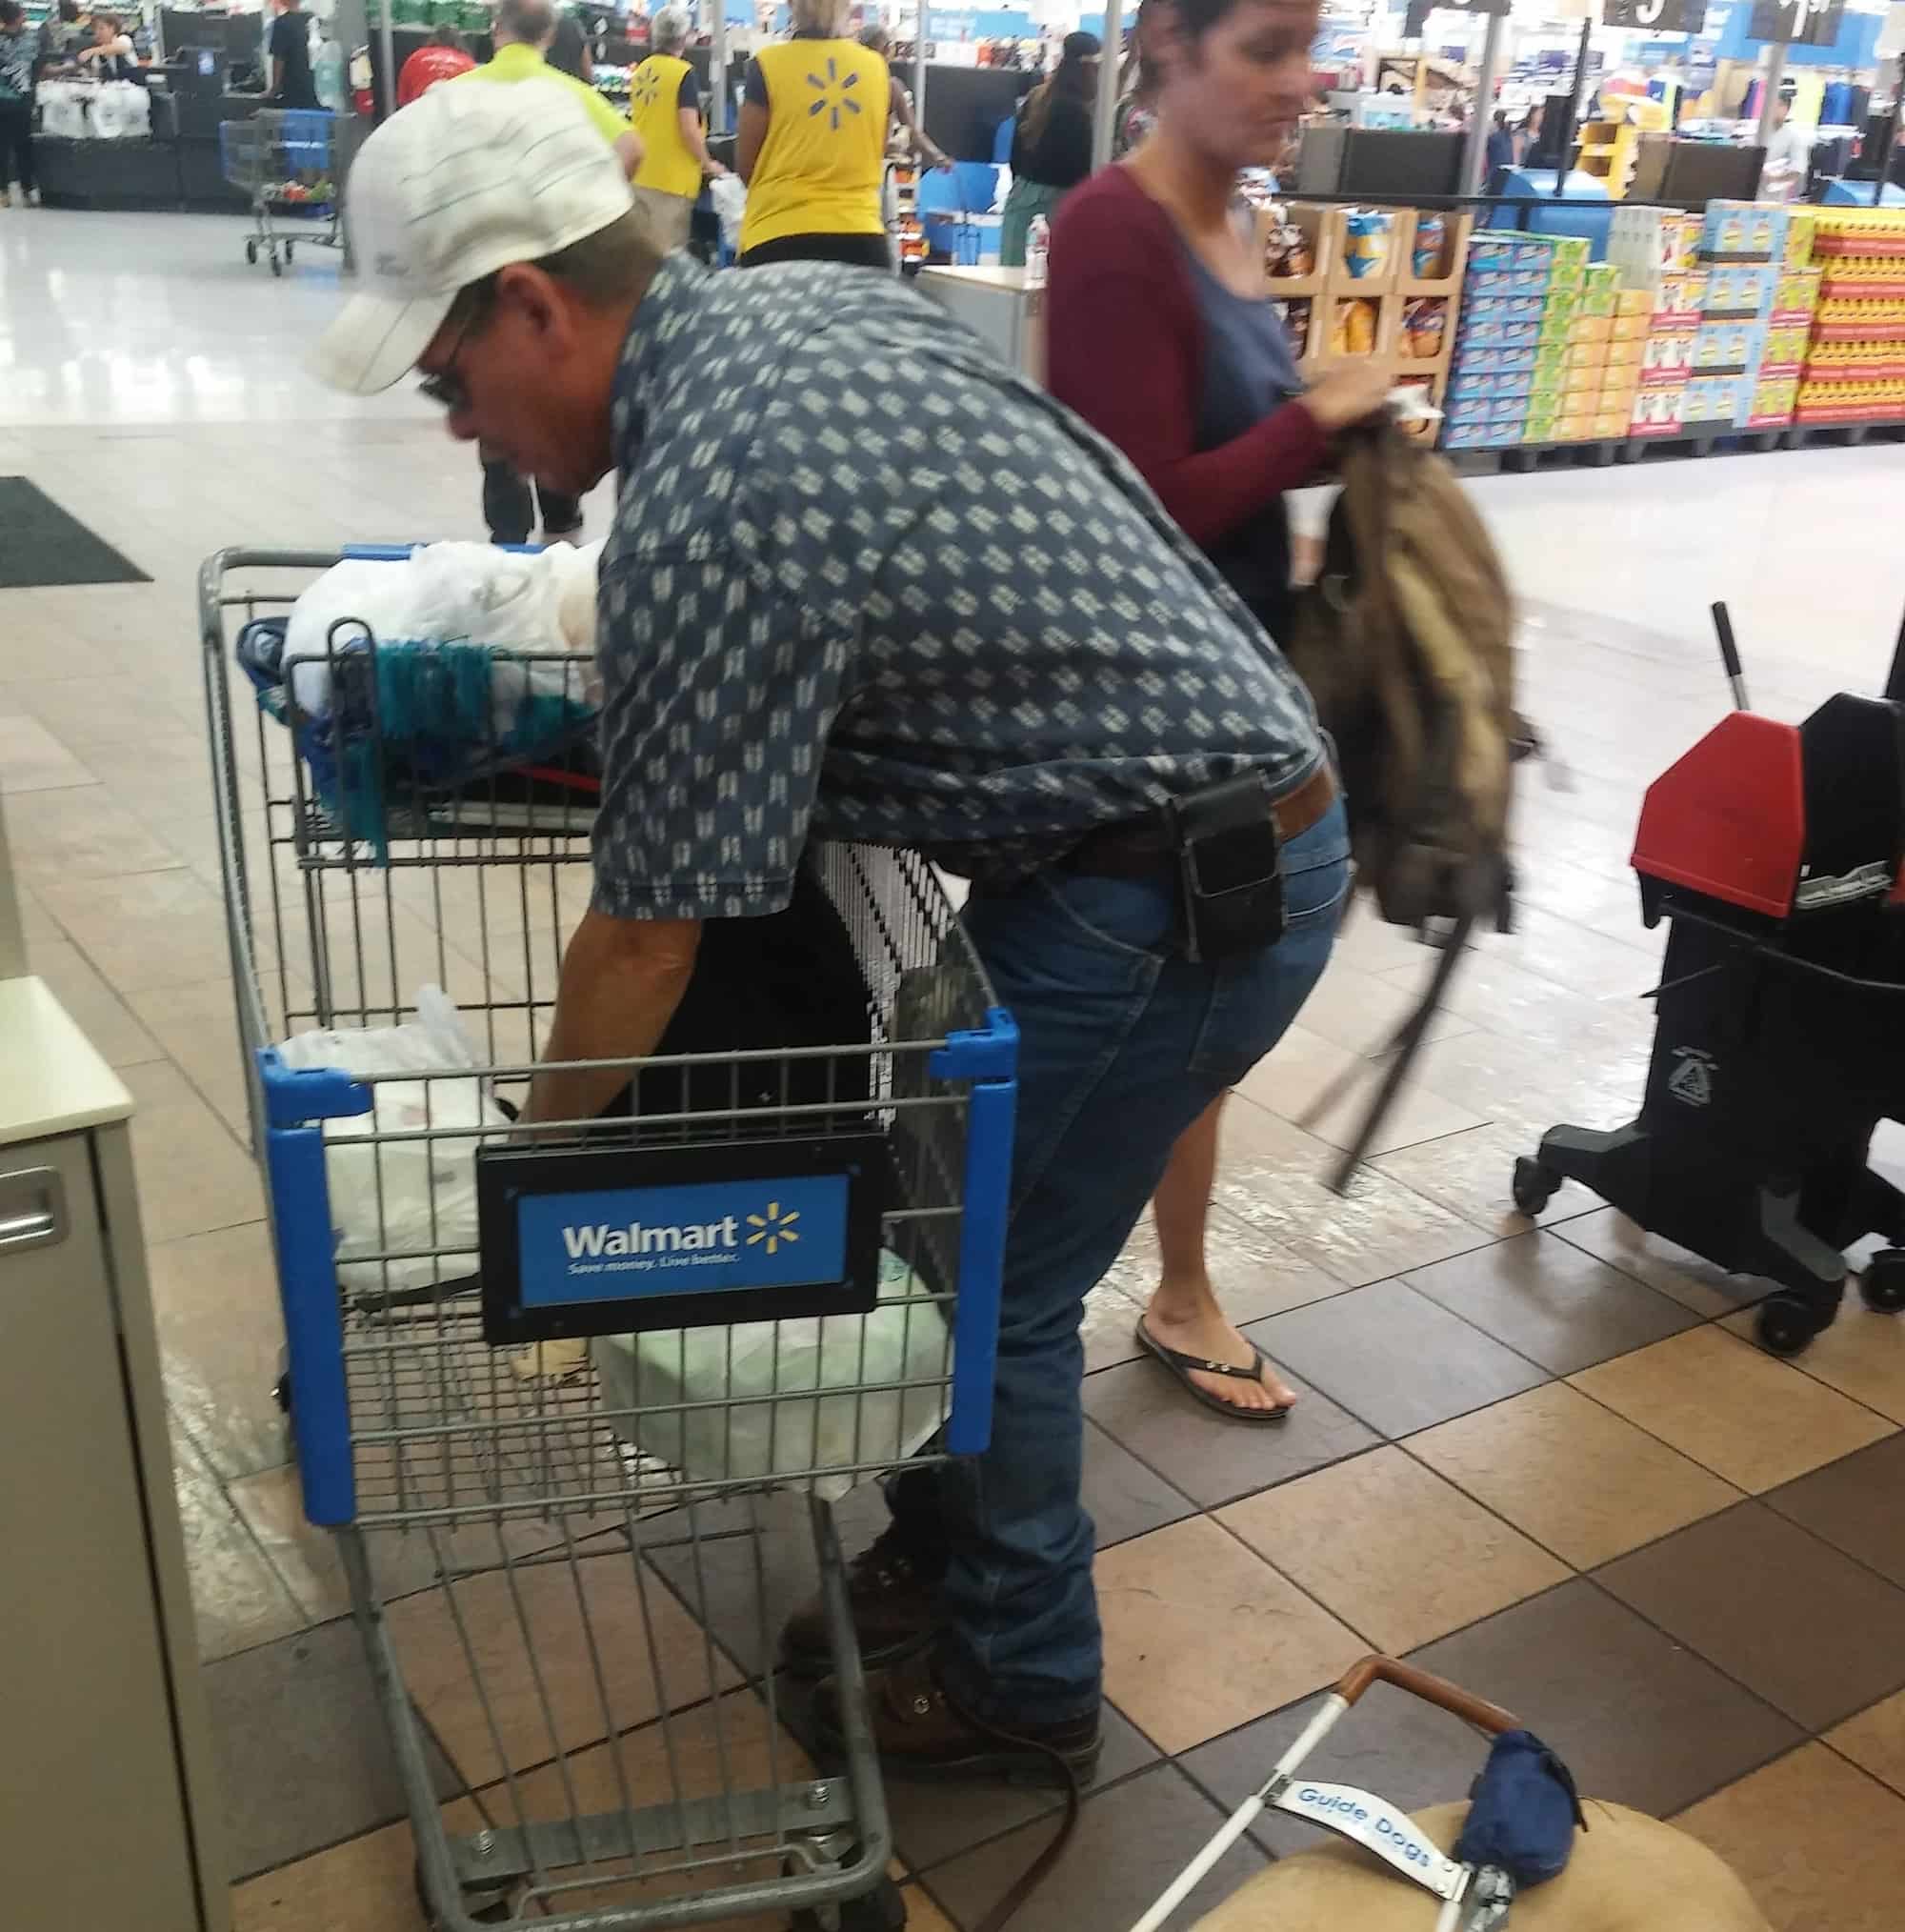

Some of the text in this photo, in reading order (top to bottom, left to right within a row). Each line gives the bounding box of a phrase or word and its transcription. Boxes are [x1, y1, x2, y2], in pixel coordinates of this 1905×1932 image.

[562, 1216, 739, 1258] Walmart
[569, 1254, 741, 1275] Save money. Live better.
[1298, 1788, 1432, 1867] Guide Dogs
